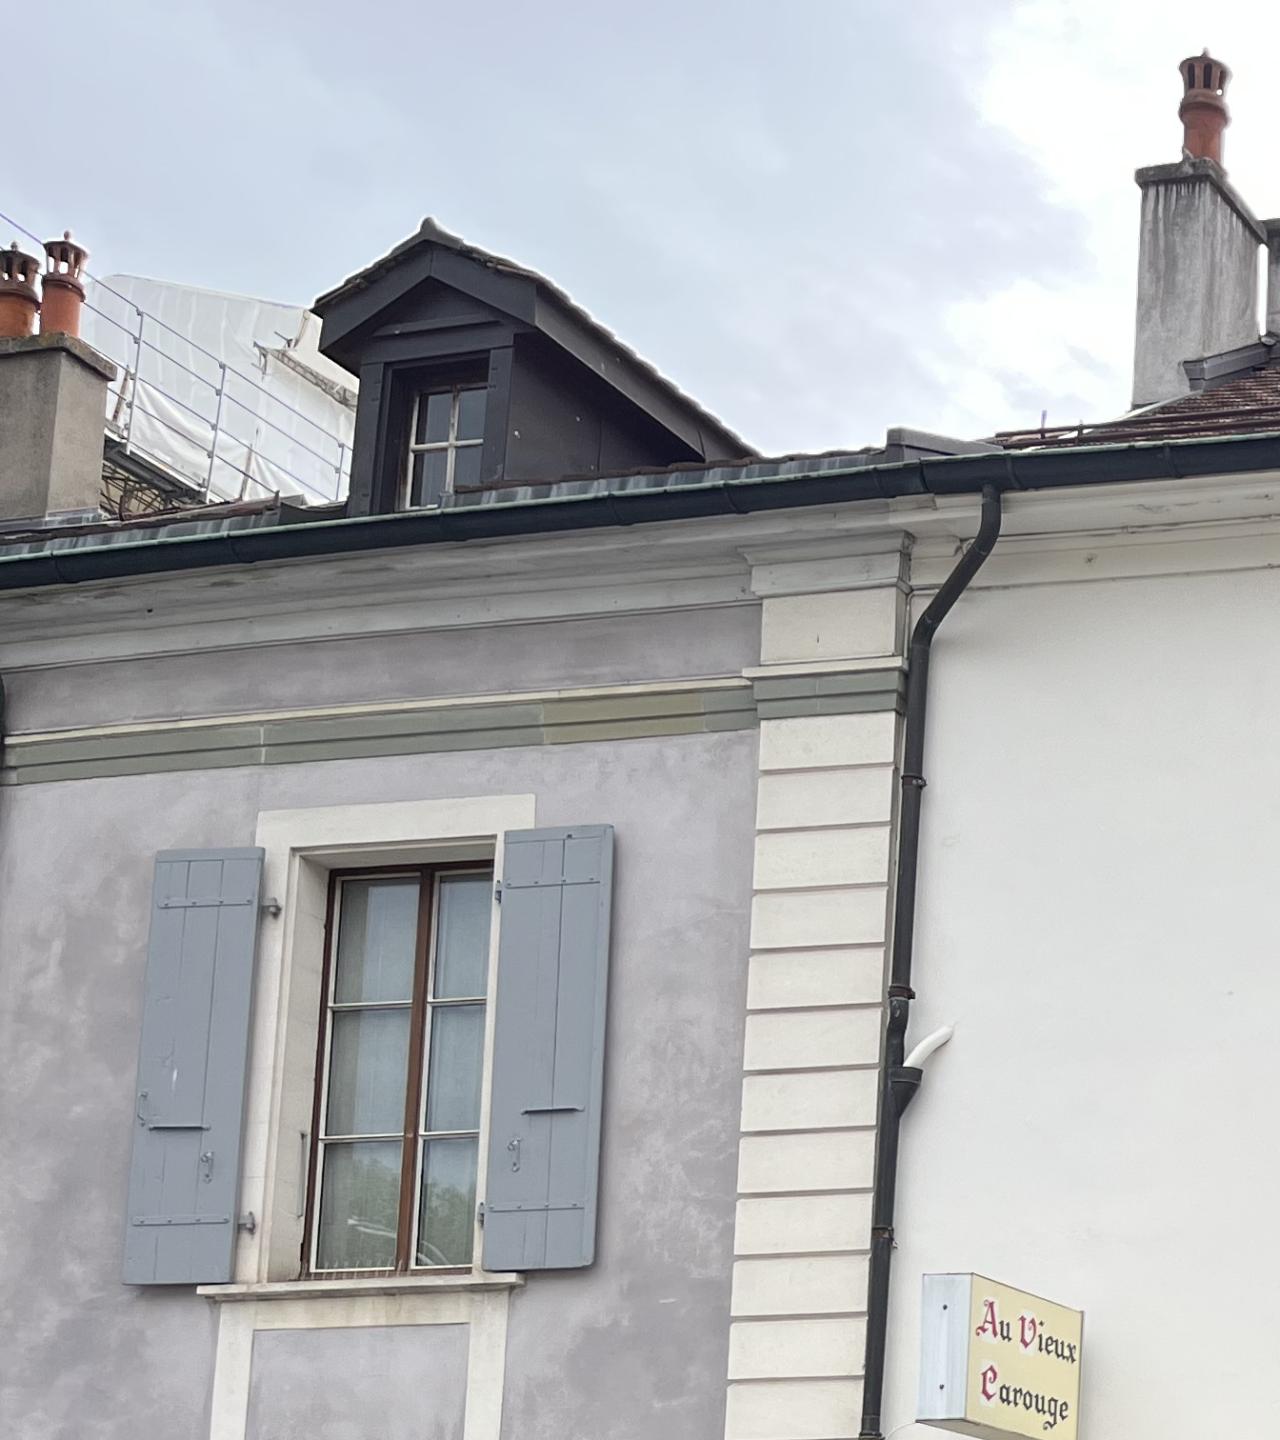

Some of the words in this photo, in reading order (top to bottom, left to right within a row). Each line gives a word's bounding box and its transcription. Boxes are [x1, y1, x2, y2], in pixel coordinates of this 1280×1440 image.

[976, 1299, 1012, 1342] Au
[1018, 1315, 1077, 1364] Vieux
[981, 1365, 1069, 1430] Carouge
